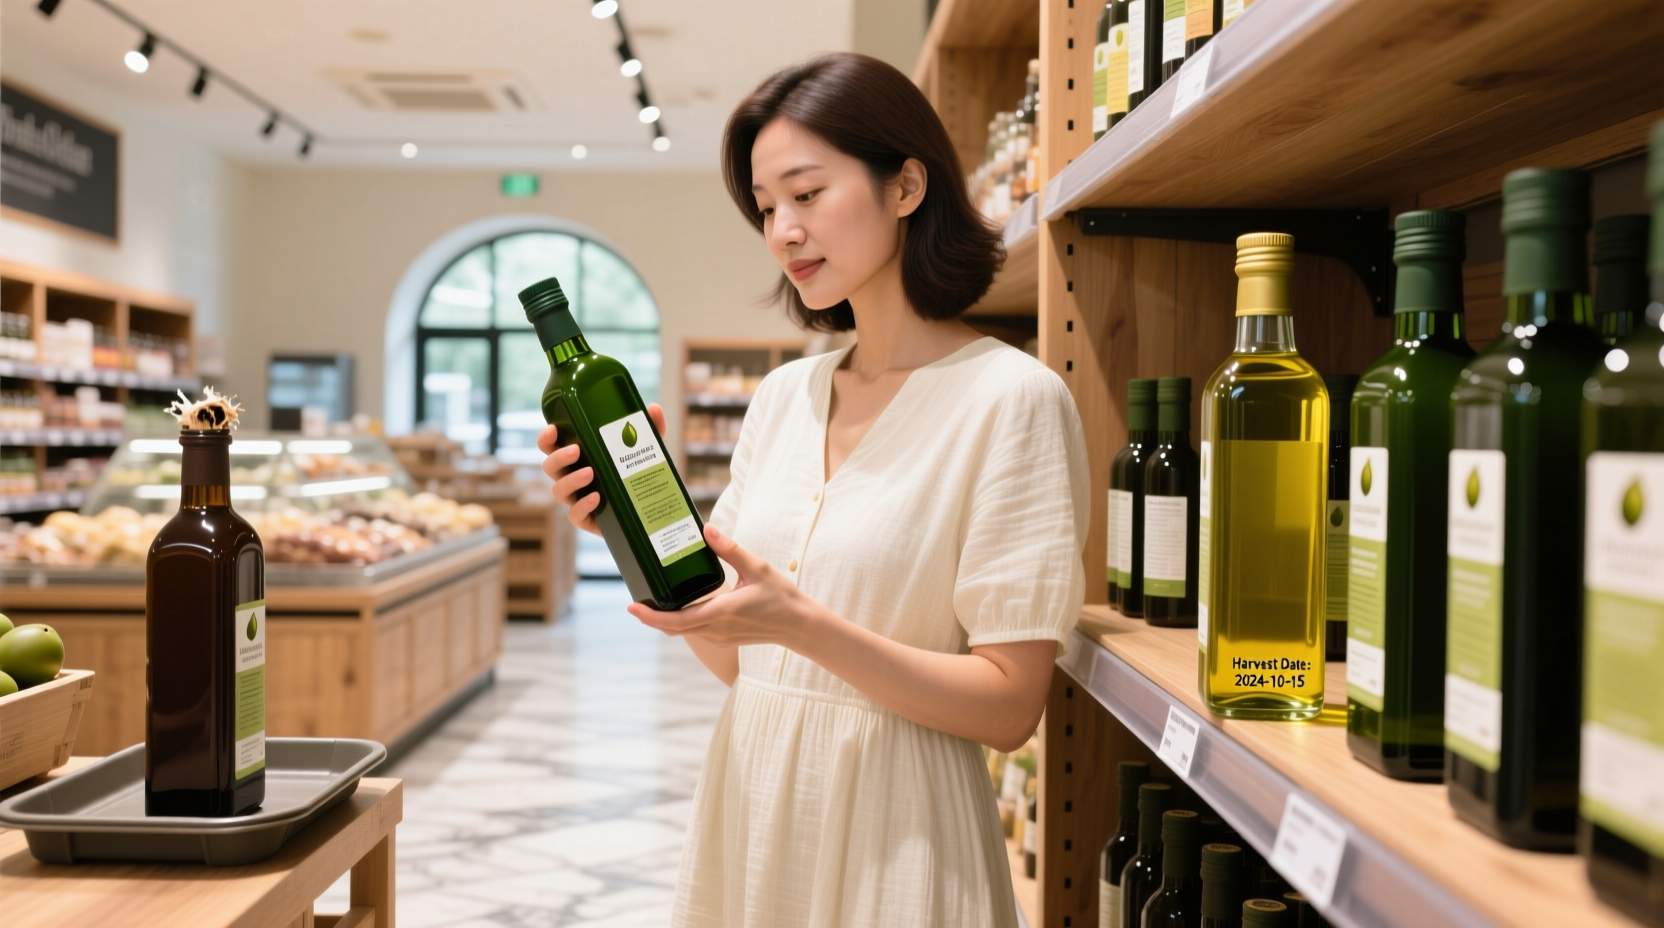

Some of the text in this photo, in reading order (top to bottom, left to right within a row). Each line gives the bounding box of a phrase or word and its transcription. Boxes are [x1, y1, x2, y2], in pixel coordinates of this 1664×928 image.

[1232, 657, 1311, 671] Harvest Date:
[1234, 674, 1305, 688] 2024-10-15
